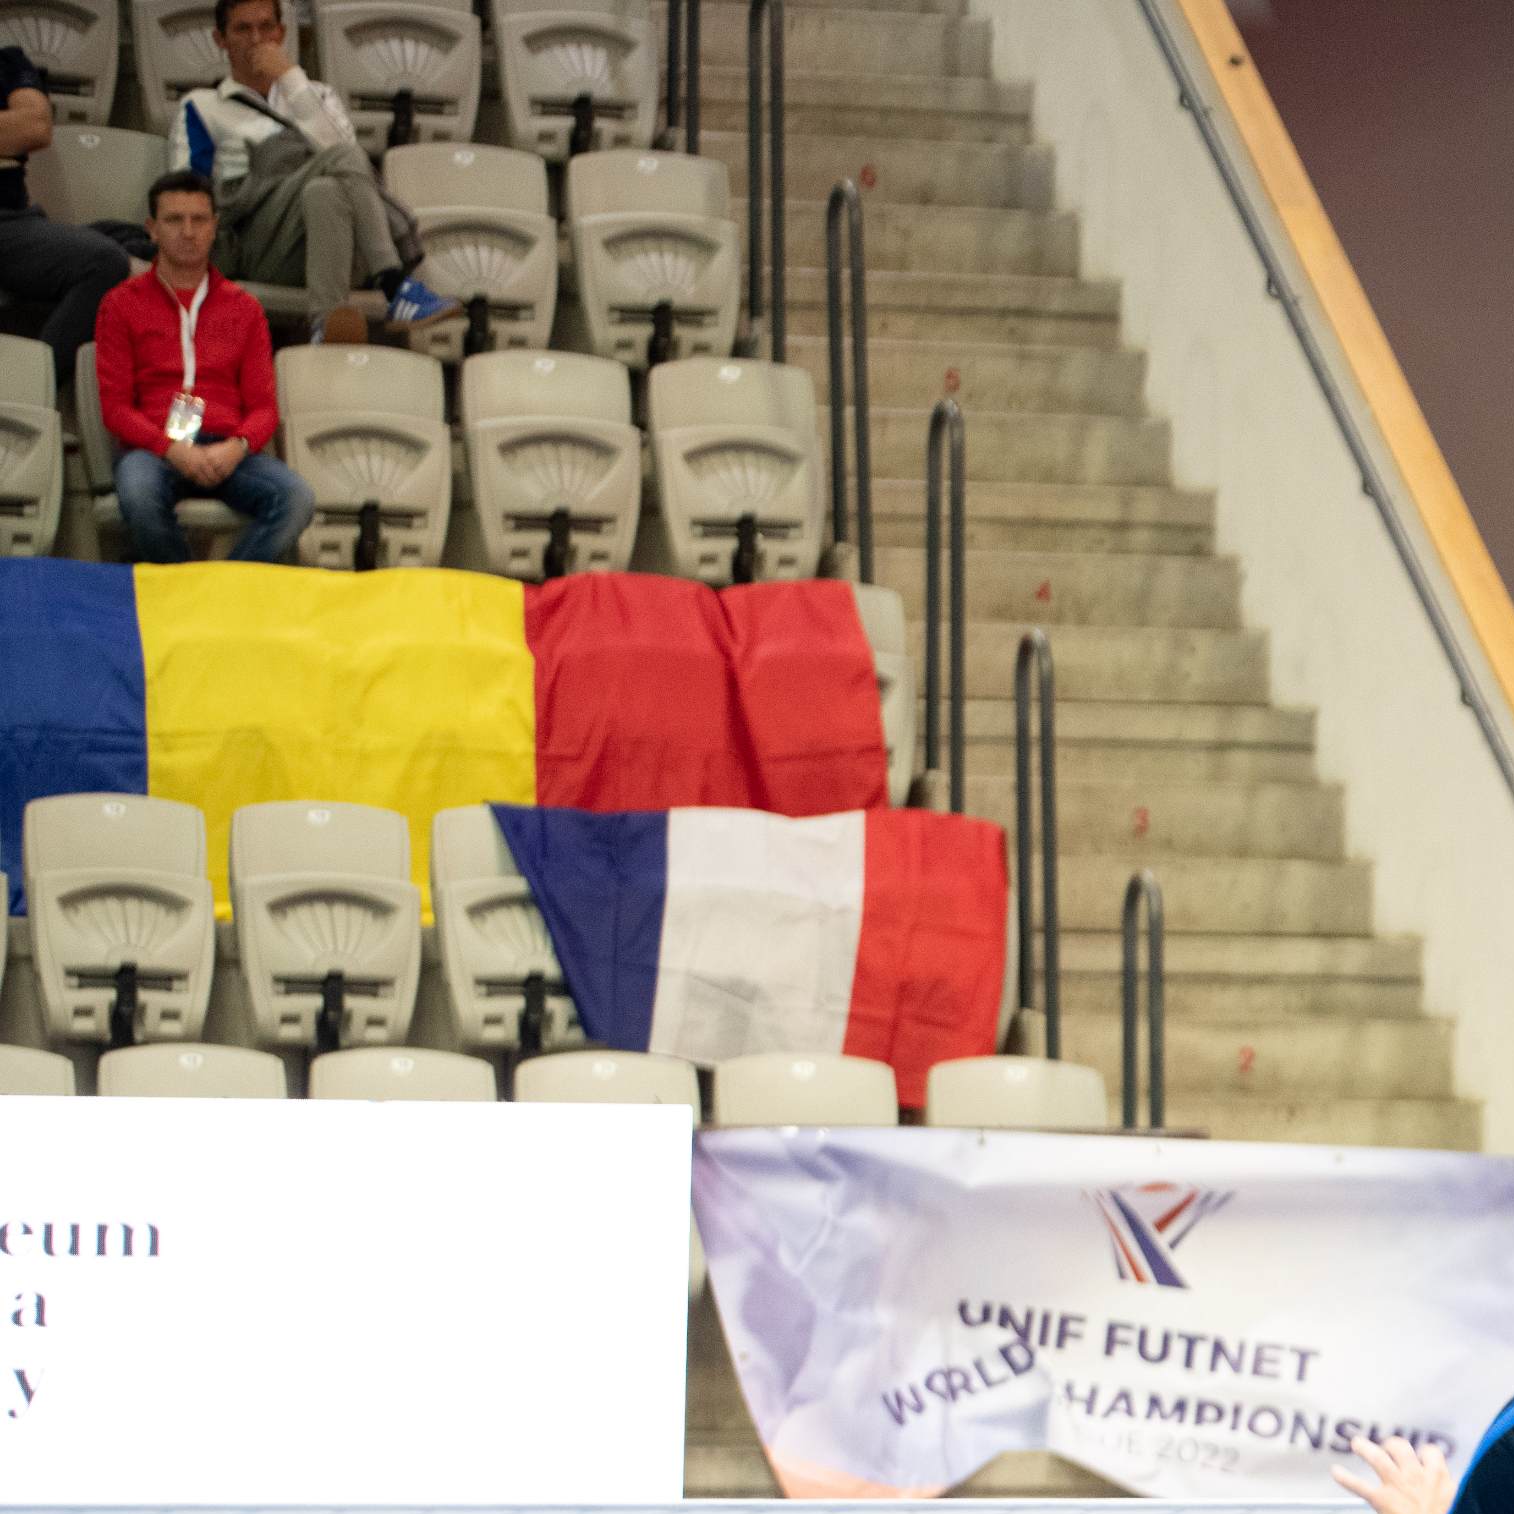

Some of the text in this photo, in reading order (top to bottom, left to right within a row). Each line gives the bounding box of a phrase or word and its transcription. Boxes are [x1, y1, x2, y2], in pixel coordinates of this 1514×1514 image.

[0, 1221, 160, 1257] eum
[11, 1291, 47, 1327] a
[957, 1299, 1320, 1384] UNIF FUTNET
[8, 1368, 46, 1419] y
[1062, 1380, 1457, 1459] HAMPIONSHIP
